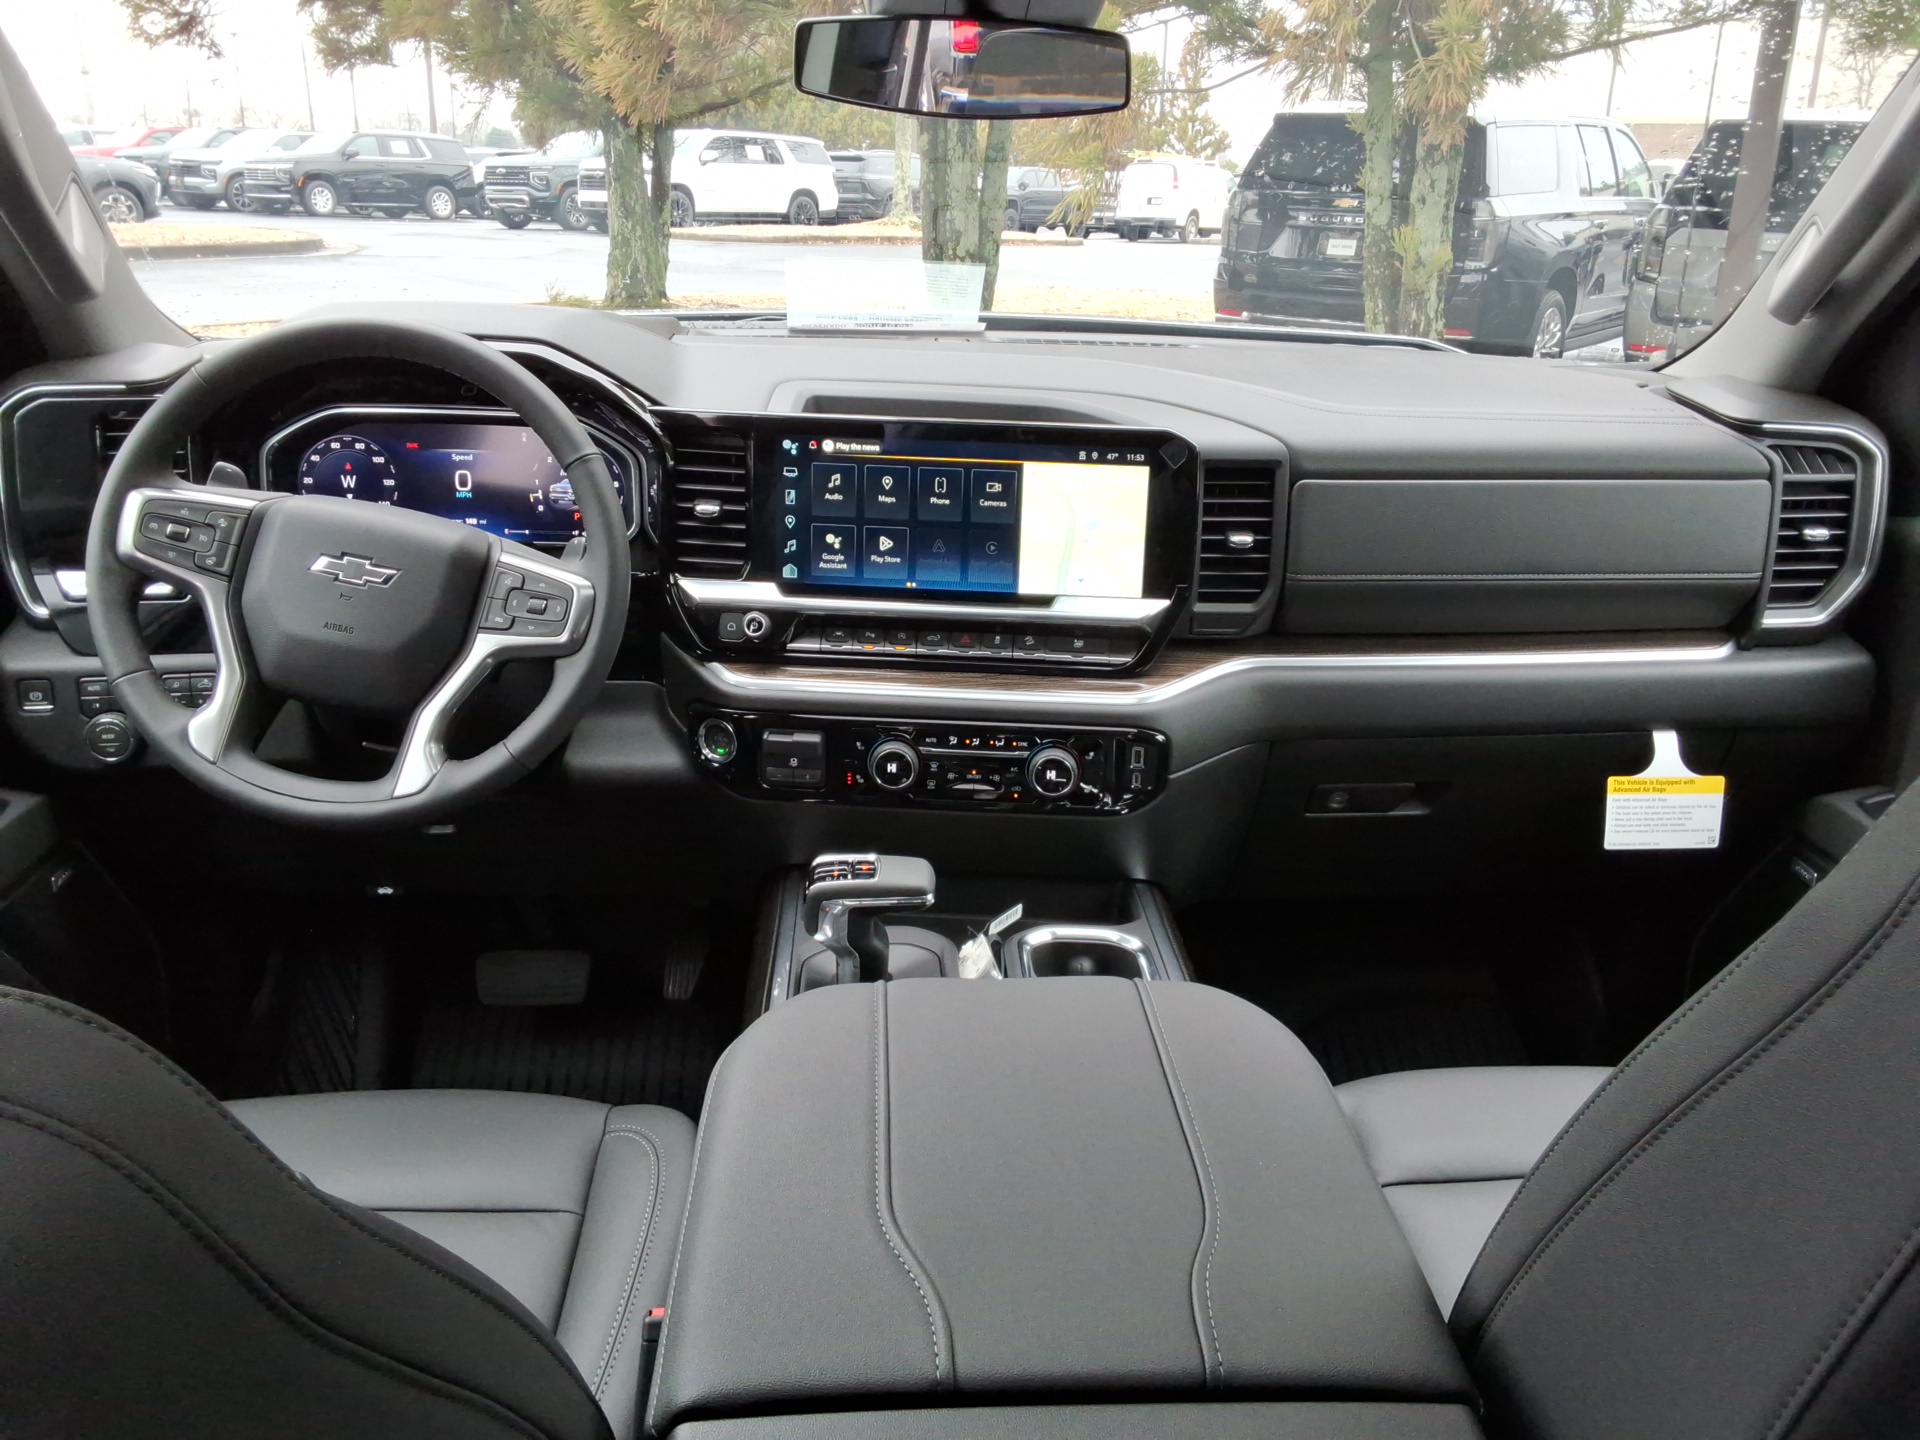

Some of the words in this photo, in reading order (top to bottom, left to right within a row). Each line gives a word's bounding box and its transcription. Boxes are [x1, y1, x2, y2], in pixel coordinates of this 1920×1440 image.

[1299, 214, 1364, 223] SUBURB
[835, 442, 850, 451] Play
[451, 453, 473, 462] Speed
[340, 475, 357, 489] W
[455, 470, 472, 491] 0
[456, 491, 472, 499] MPH
[878, 494, 896, 503] Maps
[930, 497, 950, 505] Phone
[979, 499, 1007, 507] Cameras
[574, 512, 581, 520] P
[821, 553, 845, 562] Google
[870, 555, 884, 563] Play
[819, 561, 847, 569] Assistant
[323, 621, 355, 635] AIRBAG
[1655, 779, 1681, 787] Equipped
[1652, 786, 1667, 794] Bags
